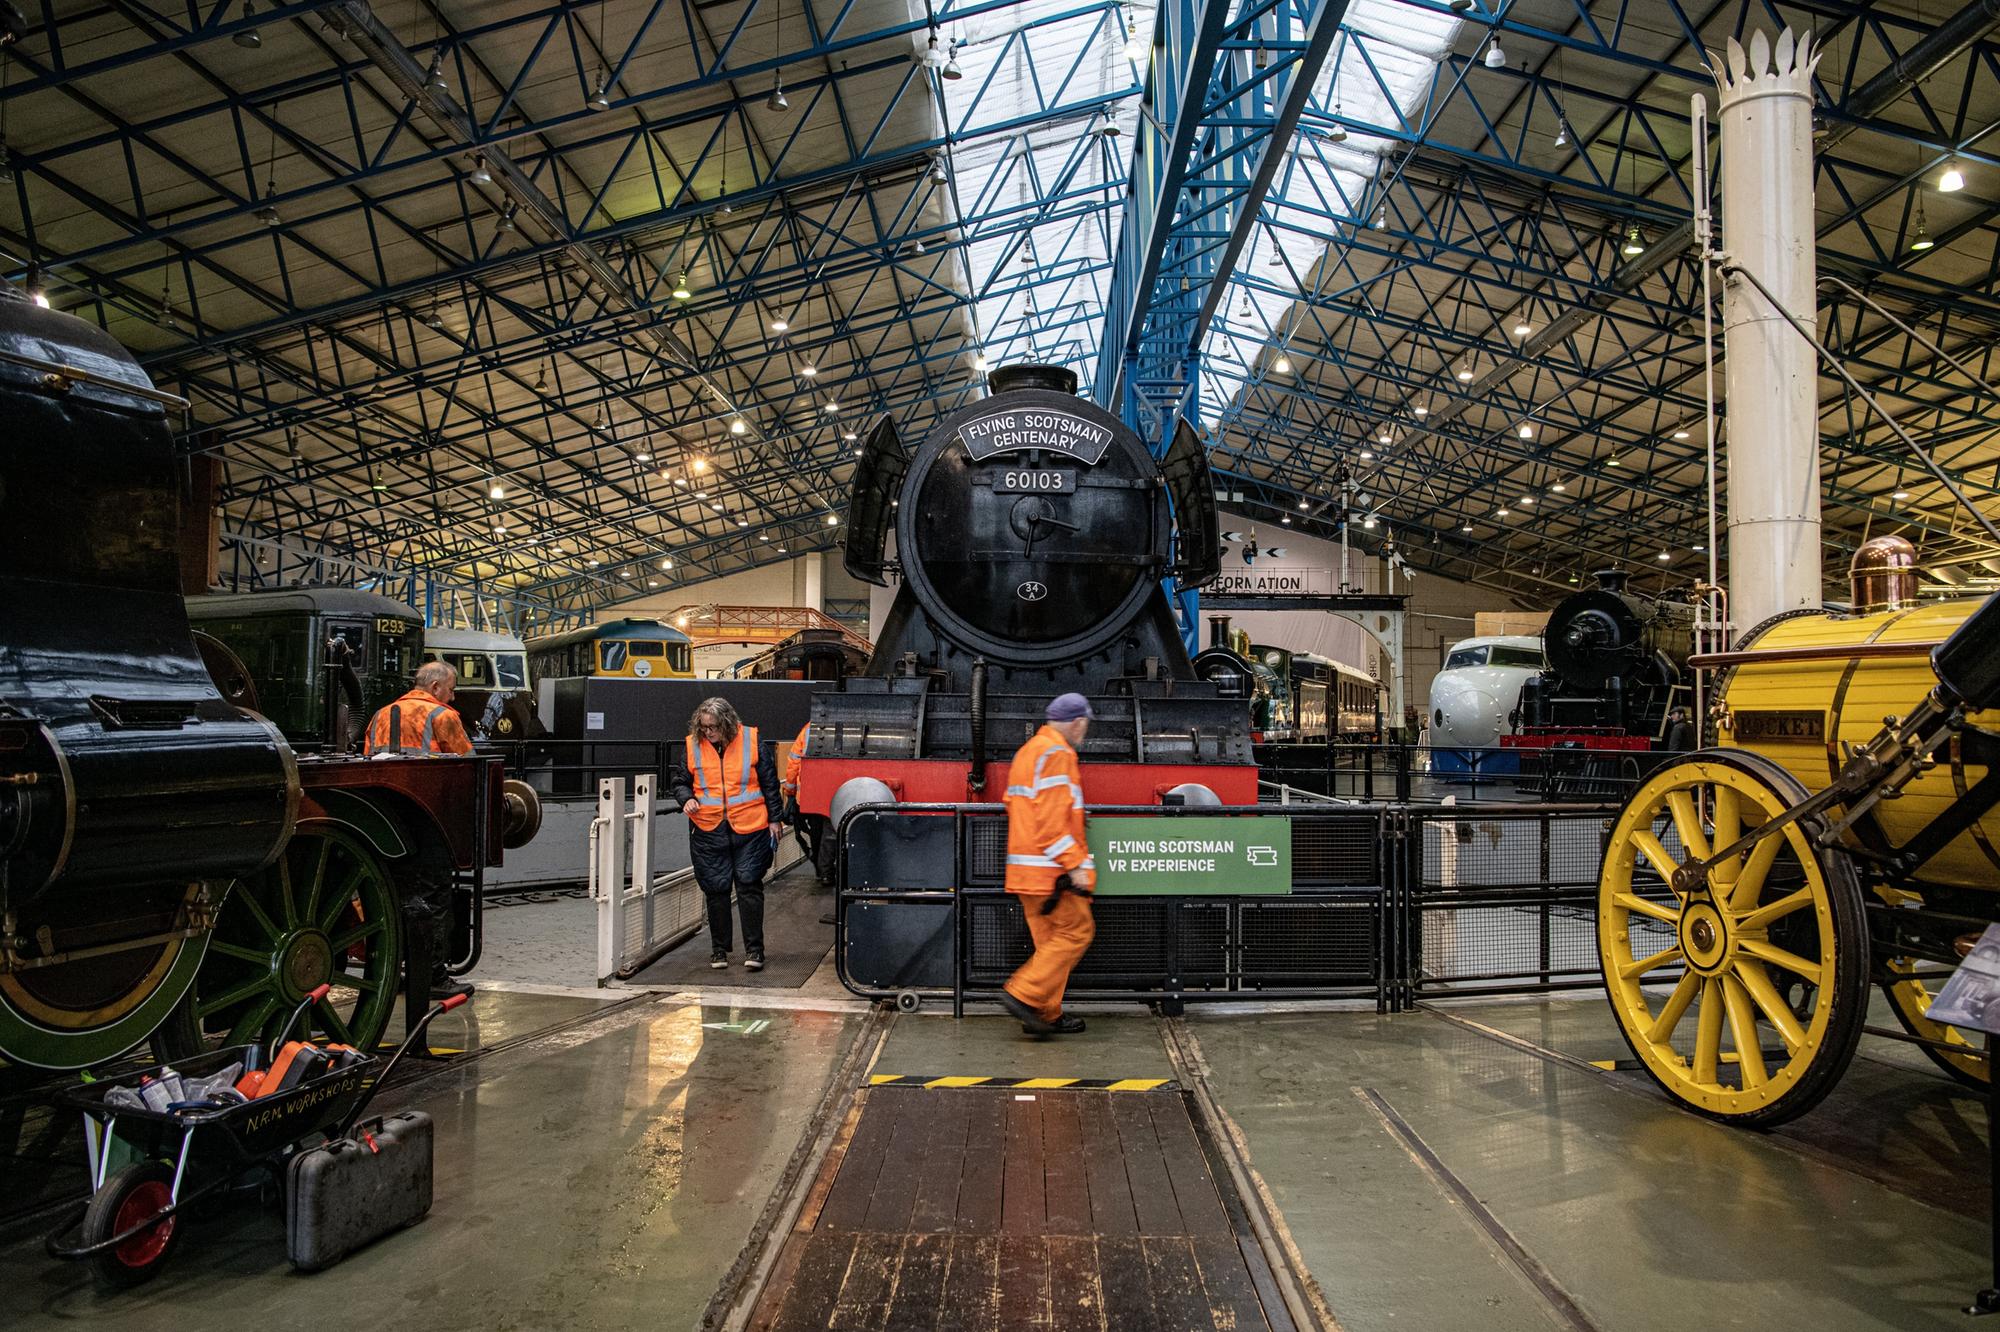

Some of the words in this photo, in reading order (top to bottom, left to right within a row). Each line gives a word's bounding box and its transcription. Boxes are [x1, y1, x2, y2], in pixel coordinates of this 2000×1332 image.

[968, 416, 1015, 440] FLYING
[1024, 415, 1103, 444] SCOTSMAN
[993, 431, 1079, 450] CENTENARY
[1005, 471, 1063, 489] 60103
[1025, 583, 1039, 593] 34
[1208, 576, 1300, 590] FORMATION
[377, 619, 405, 634] 1293
[1369, 654, 1378, 678] SHOP
[1108, 841, 1156, 854] FLYING
[1159, 840, 1234, 854] SCOTSMAN
[1108, 859, 1127, 872] VR
[1131, 859, 1215, 872] EXPERIENCE
[286, 1079, 356, 1114] WORKSHOPS
